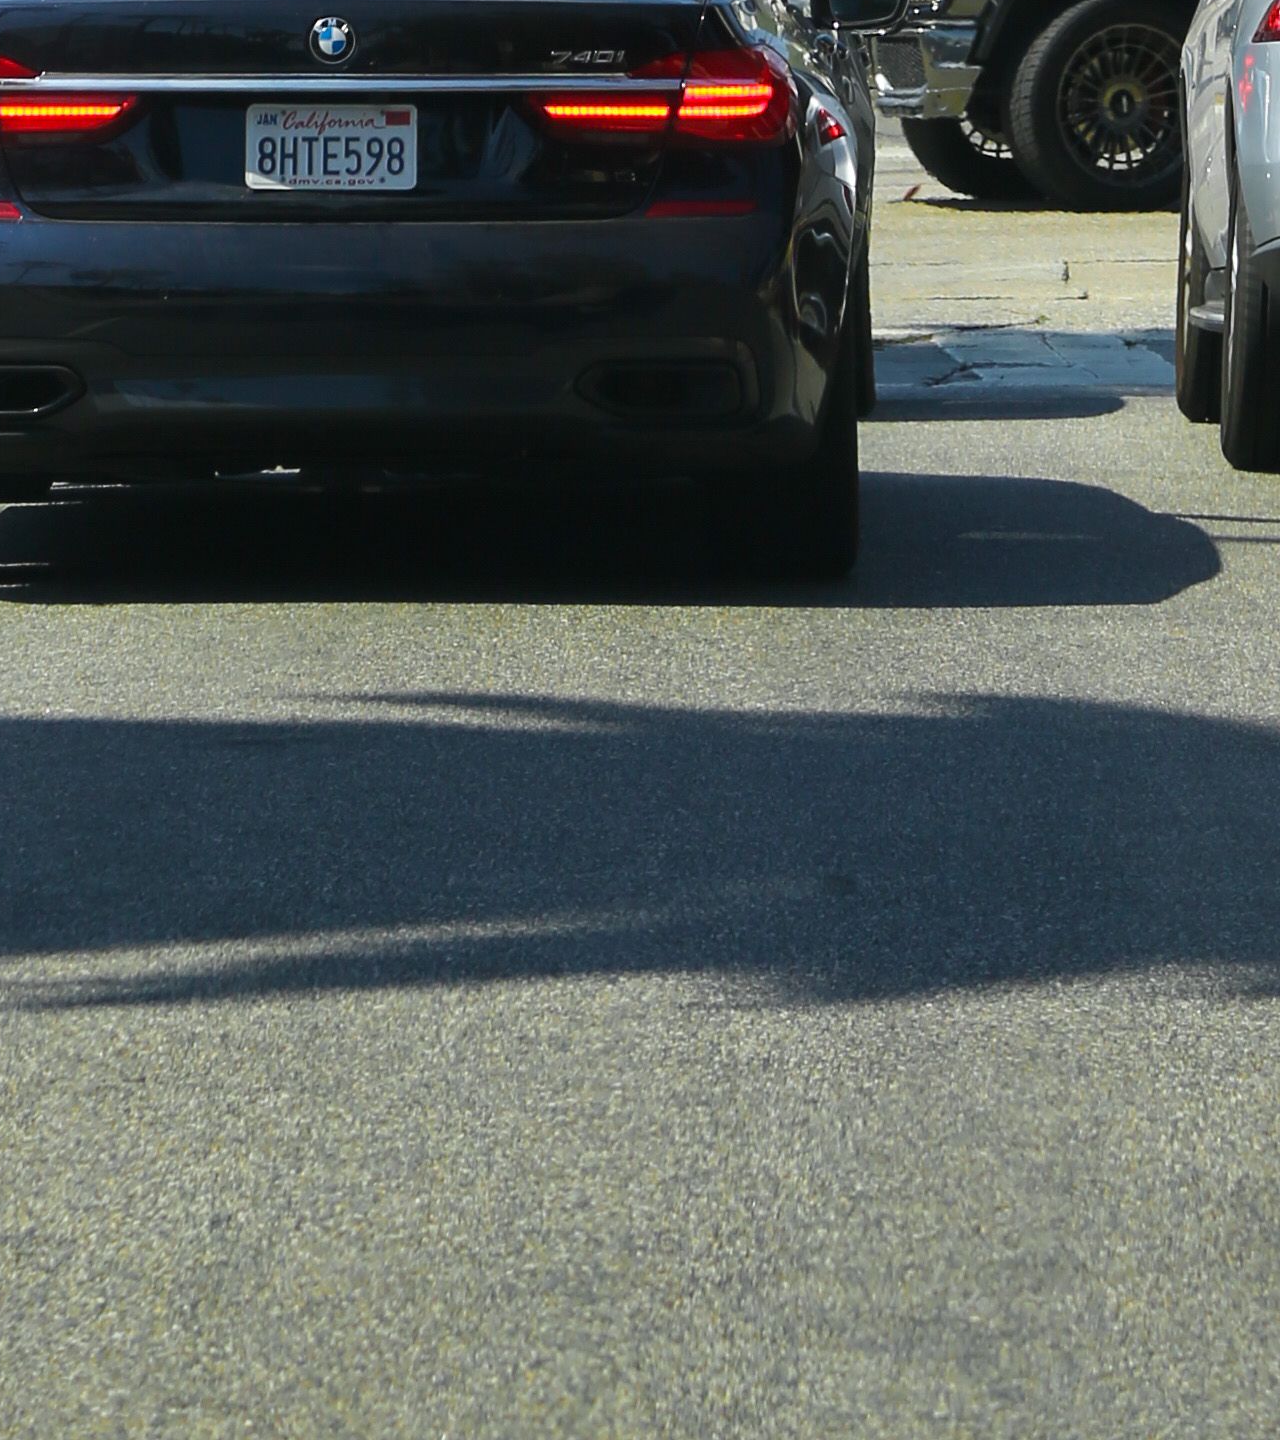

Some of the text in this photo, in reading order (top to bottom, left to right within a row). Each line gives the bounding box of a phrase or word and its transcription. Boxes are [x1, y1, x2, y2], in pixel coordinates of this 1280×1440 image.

[256, 112, 278, 126] JAN
[282, 110, 386, 135] California
[257, 136, 405, 176] 8HTE598
[288, 177, 376, 186] dmv.ca.gov
